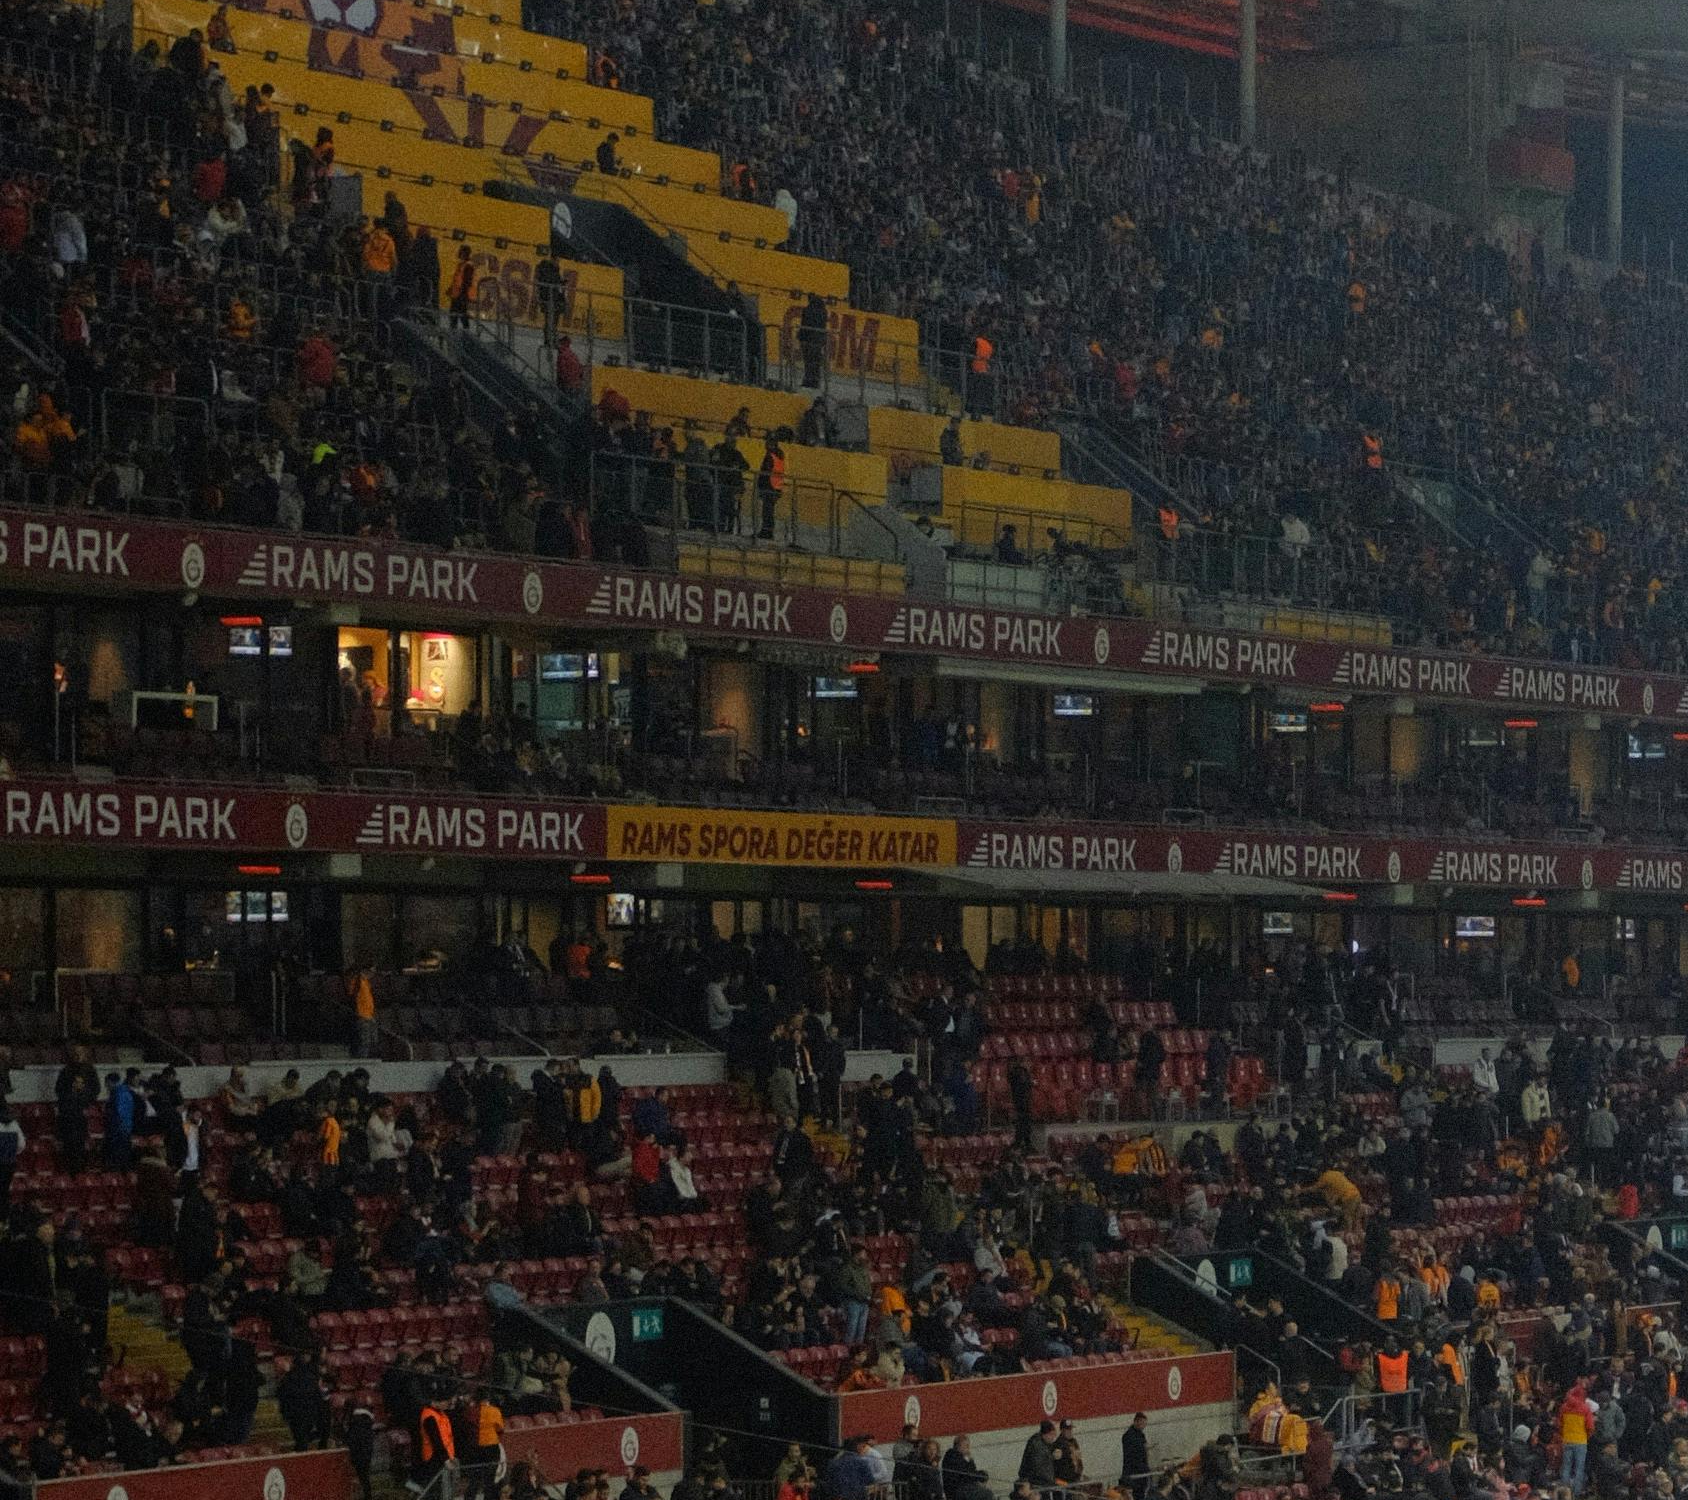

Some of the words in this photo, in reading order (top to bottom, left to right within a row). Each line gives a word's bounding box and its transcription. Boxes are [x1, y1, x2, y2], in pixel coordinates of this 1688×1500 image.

[24, 522, 130, 576] PARK
[273, 545, 375, 594] RAMS
[388, 554, 478, 602] PARK
[616, 576, 704, 624] RAMS
[714, 588, 793, 632] PARK
[910, 607, 986, 650] RAMS
[994, 616, 1062, 656] PARK
[1164, 631, 1230, 671] RAMS
[1237, 638, 1297, 677] PARK
[1353, 651, 1412, 689] RAMS
[1418, 658, 1472, 694] PARK
[1512, 667, 1566, 703] RAMS
[1571, 673, 1620, 708] PARK
[7, 790, 121, 837] RAMS
[135, 794, 236, 840] PARK
[389, 804, 486, 848] RAMS
[498, 809, 584, 851] PARK
[621, 823, 691, 855] RAMS
[697, 824, 778, 860] SPORA
[785, 818, 862, 861] DEĞER
[868, 830, 939, 863] KATAR
[992, 832, 1063, 871] RAMS
[1073, 836, 1137, 873] PARK
[1232, 842, 1298, 877] RAMS
[1304, 845, 1361, 878] PARK
[1446, 850, 1502, 883] RAMS
[1508, 853, 1558, 885] PARK
[1633, 859, 1683, 890] RAMS
